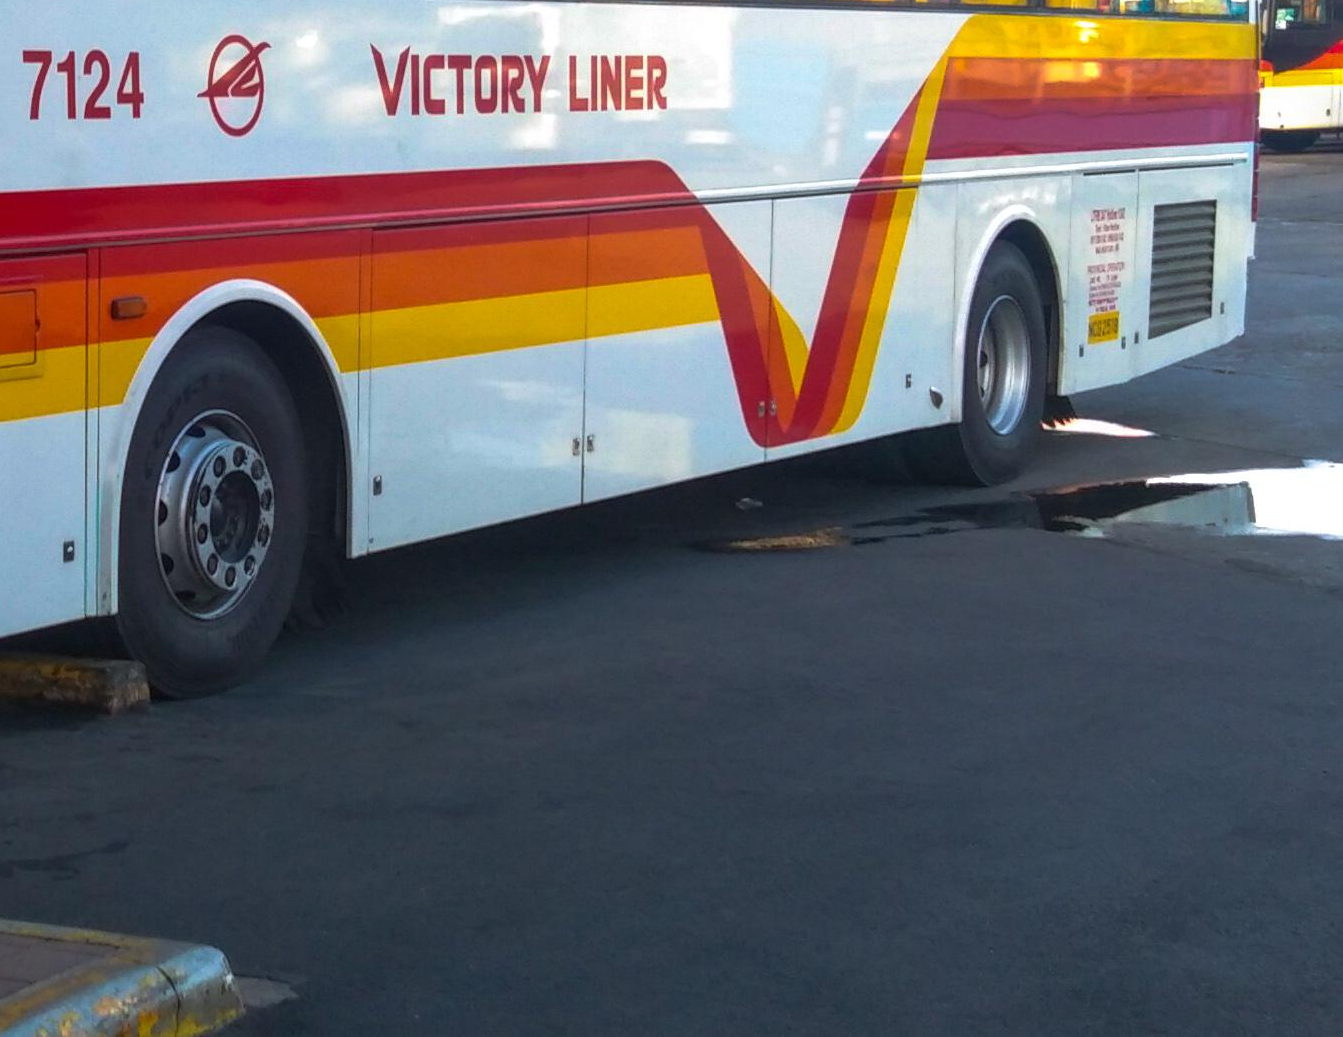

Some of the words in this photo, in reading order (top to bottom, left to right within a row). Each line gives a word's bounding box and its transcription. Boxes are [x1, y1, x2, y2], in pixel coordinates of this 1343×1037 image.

[22, 49, 145, 120] 7124
[369, 43, 551, 116] VICTORY
[568, 54, 668, 112] LINER
